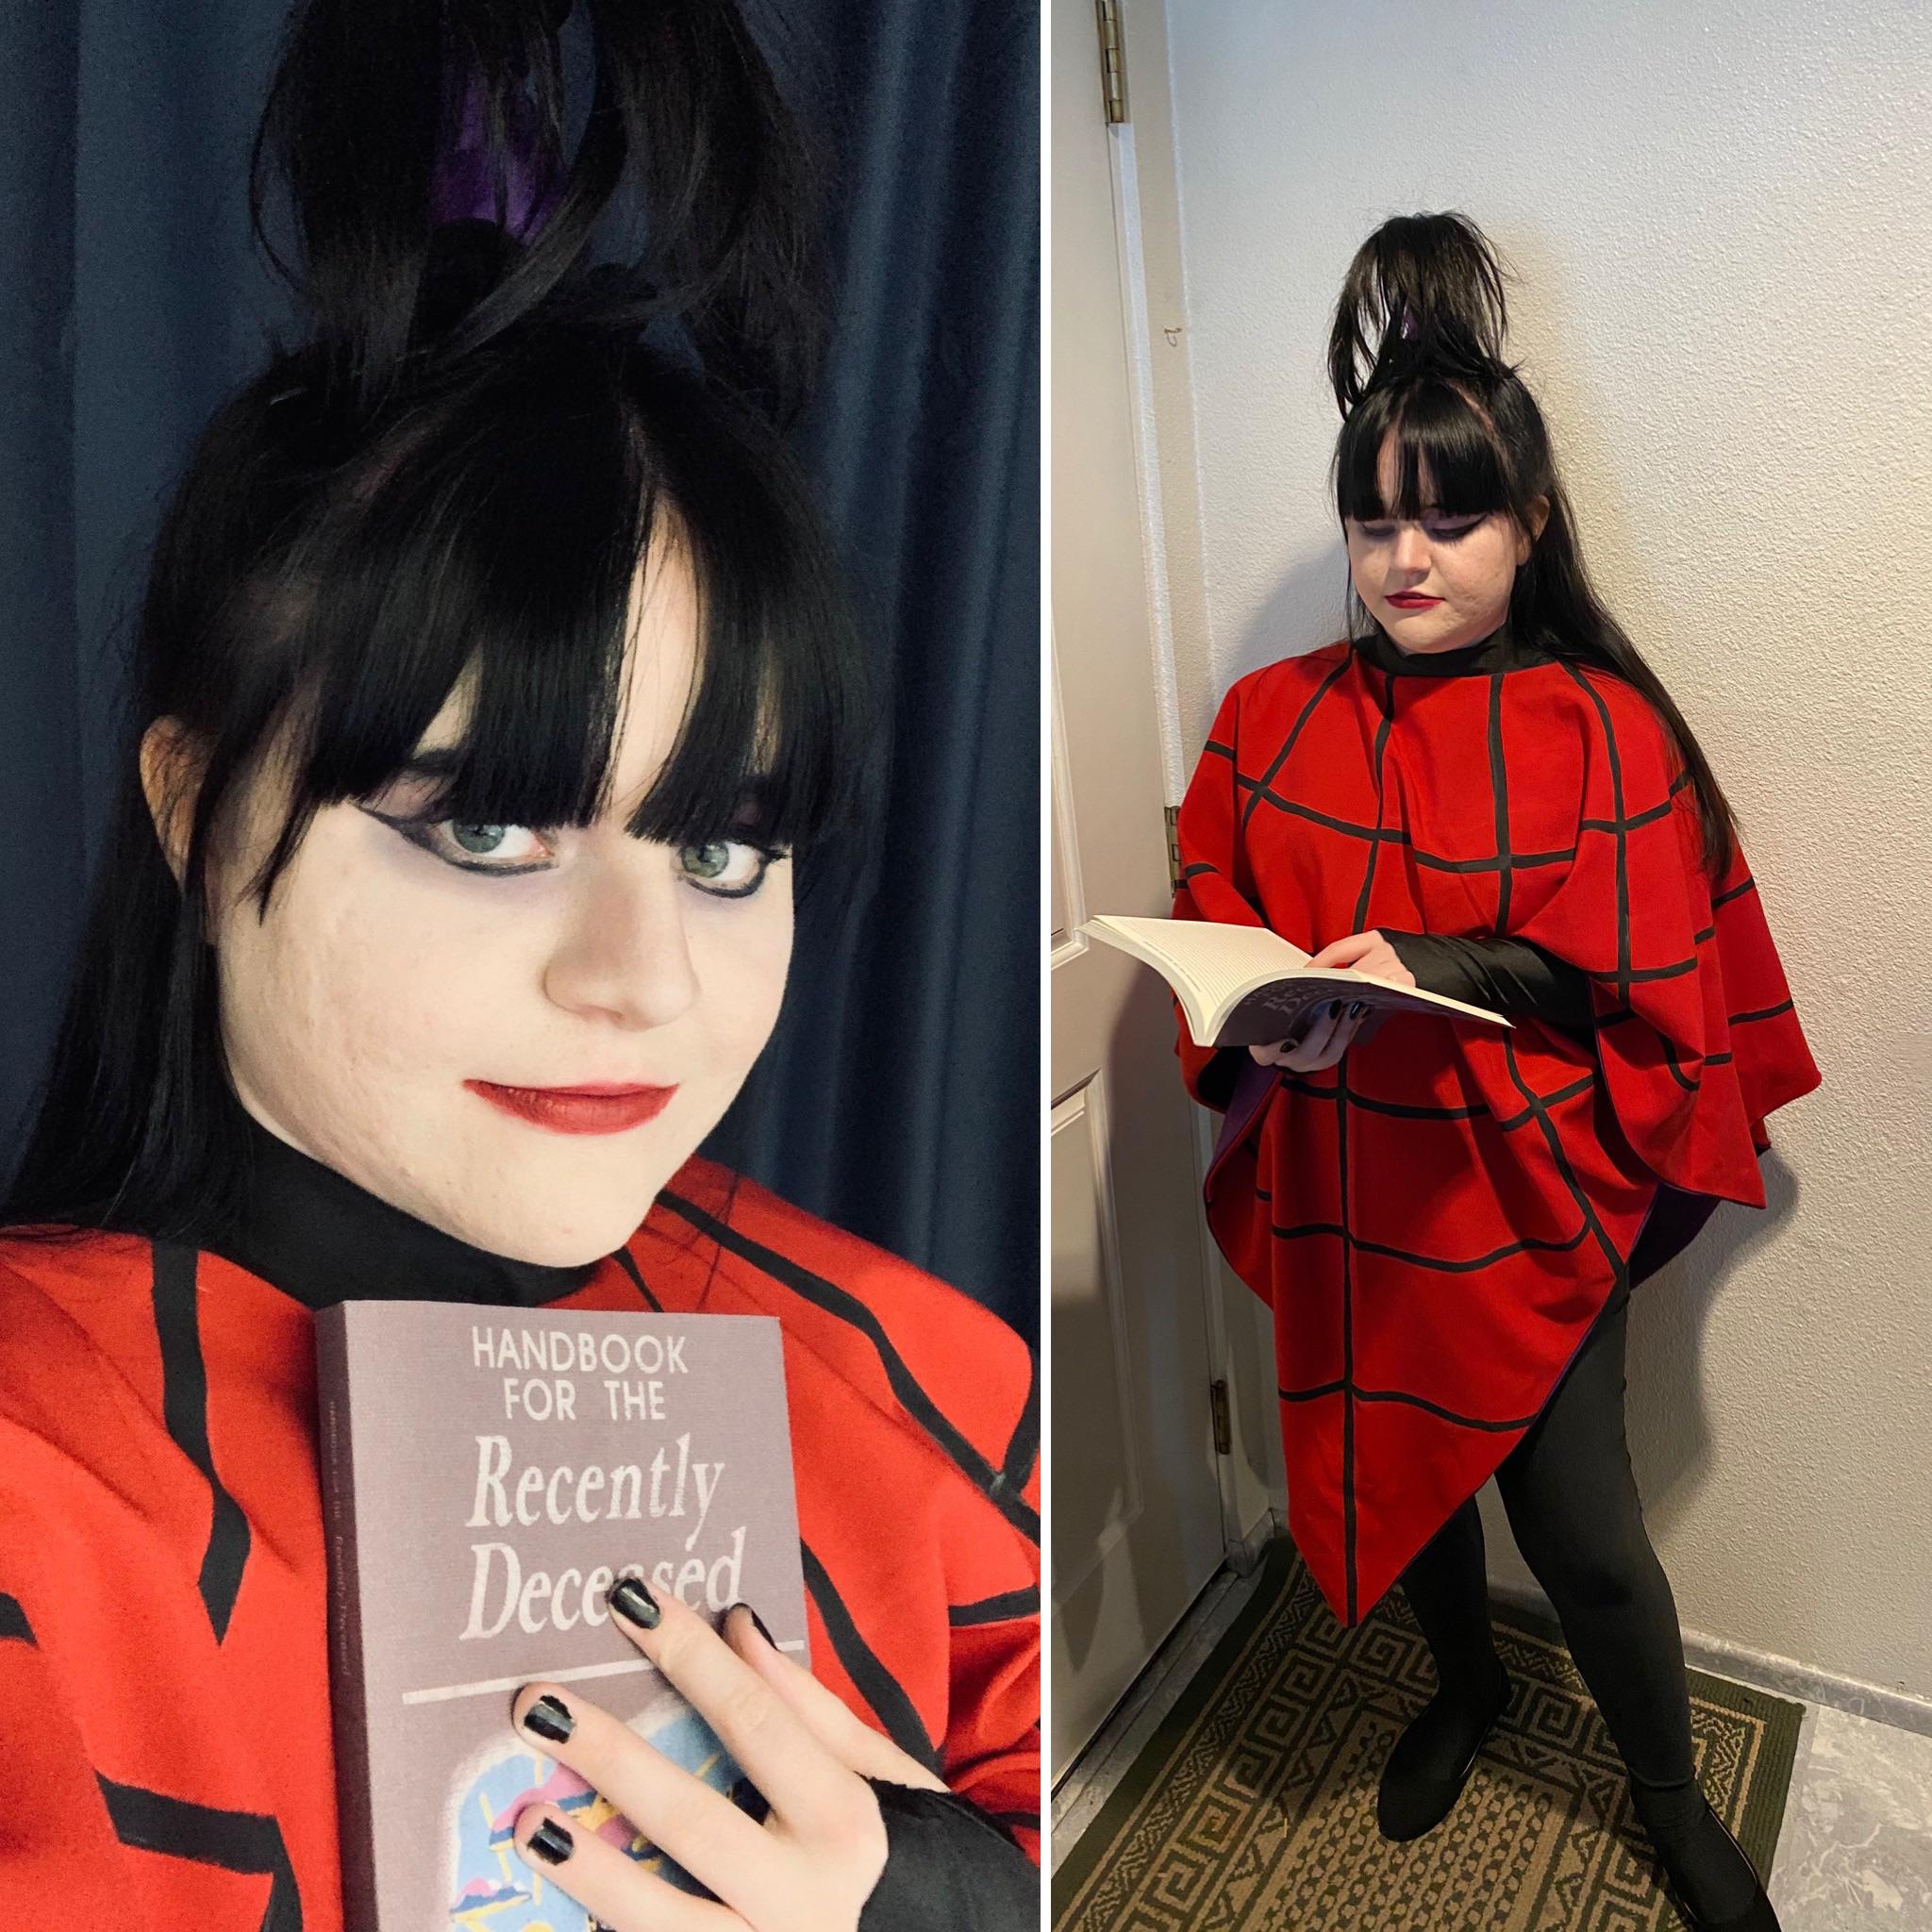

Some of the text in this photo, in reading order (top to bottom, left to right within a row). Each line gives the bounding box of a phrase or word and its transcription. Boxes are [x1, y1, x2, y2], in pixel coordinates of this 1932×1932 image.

[473, 1326, 689, 1374] HANDBOOK
[504, 1378, 666, 1421] FOR THE
[465, 1432, 725, 1552] Recently
[458, 1526, 746, 1641] Decesed
